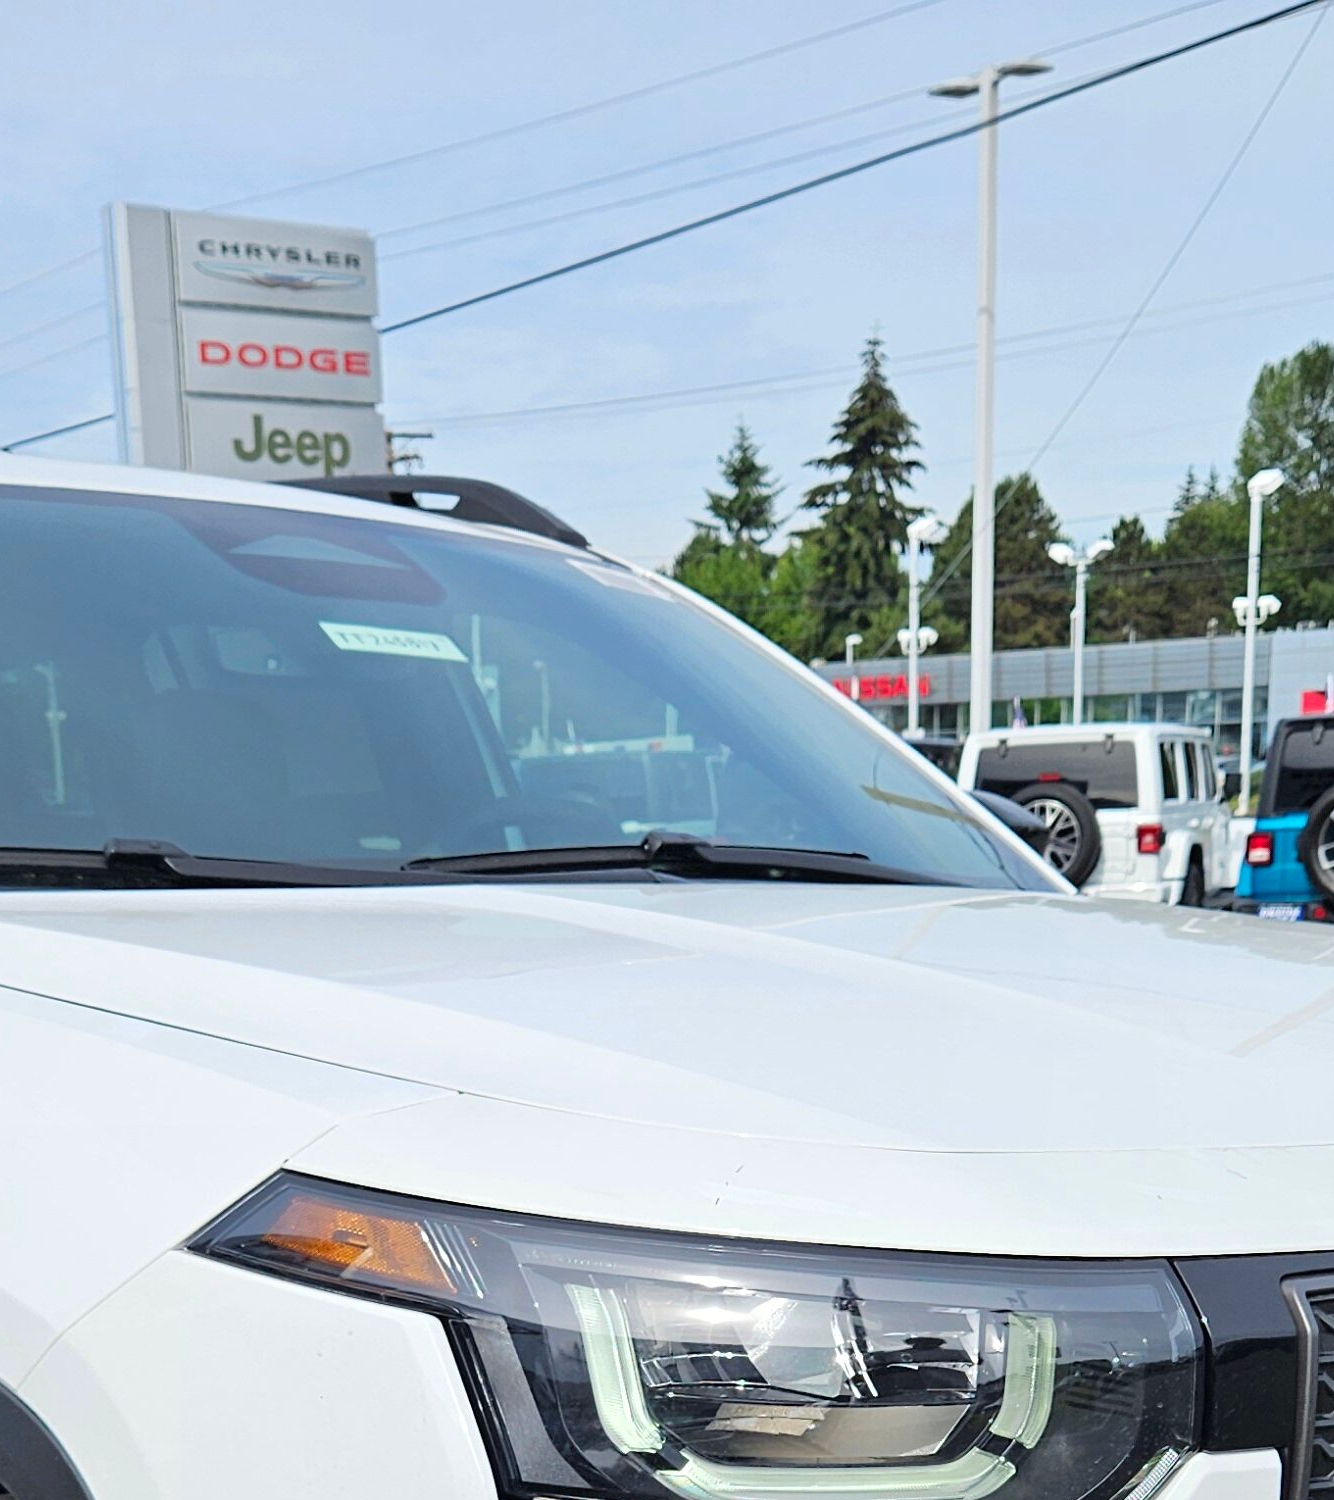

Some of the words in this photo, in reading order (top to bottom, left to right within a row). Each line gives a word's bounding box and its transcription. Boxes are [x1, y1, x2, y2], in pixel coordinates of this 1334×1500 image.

[198, 239, 362, 270] CHRYSLER
[198, 340, 371, 378] DODGE
[233, 413, 350, 478] Jeep
